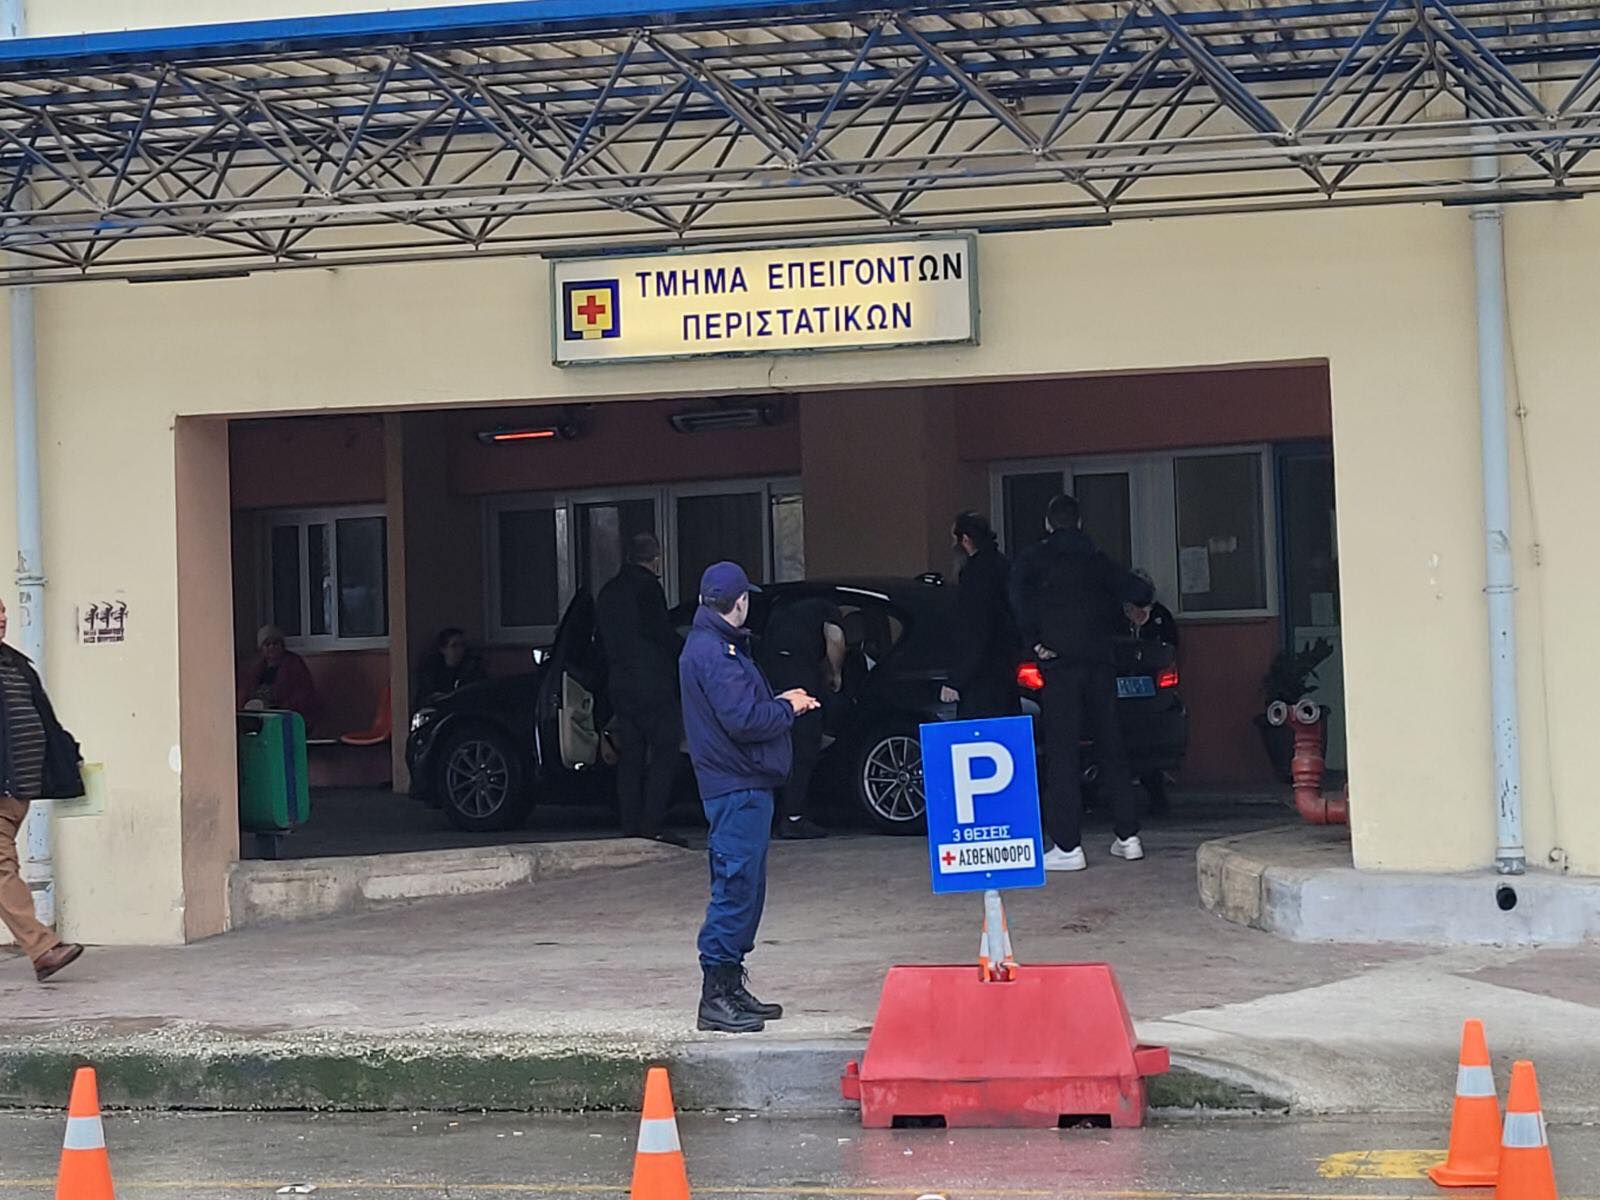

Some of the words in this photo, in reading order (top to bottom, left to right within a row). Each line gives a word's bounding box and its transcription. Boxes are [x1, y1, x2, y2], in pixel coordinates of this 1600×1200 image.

[635, 267, 748, 298] ΤΜΗΜΑ
[768, 253, 962, 290] ΕΠΕΙΓΟΝΤΩΝ
[683, 302, 912, 341] ΠΕΡΙΣΤΑΤΙΚΩΝ
[951, 741, 1014, 825] P
[952, 828, 961, 842] 3
[964, 826, 1010, 840] ΘΕΣΕΙΣ
[959, 845, 1031, 866] ΑΣΘΕΝΟΦΟΡΟ
